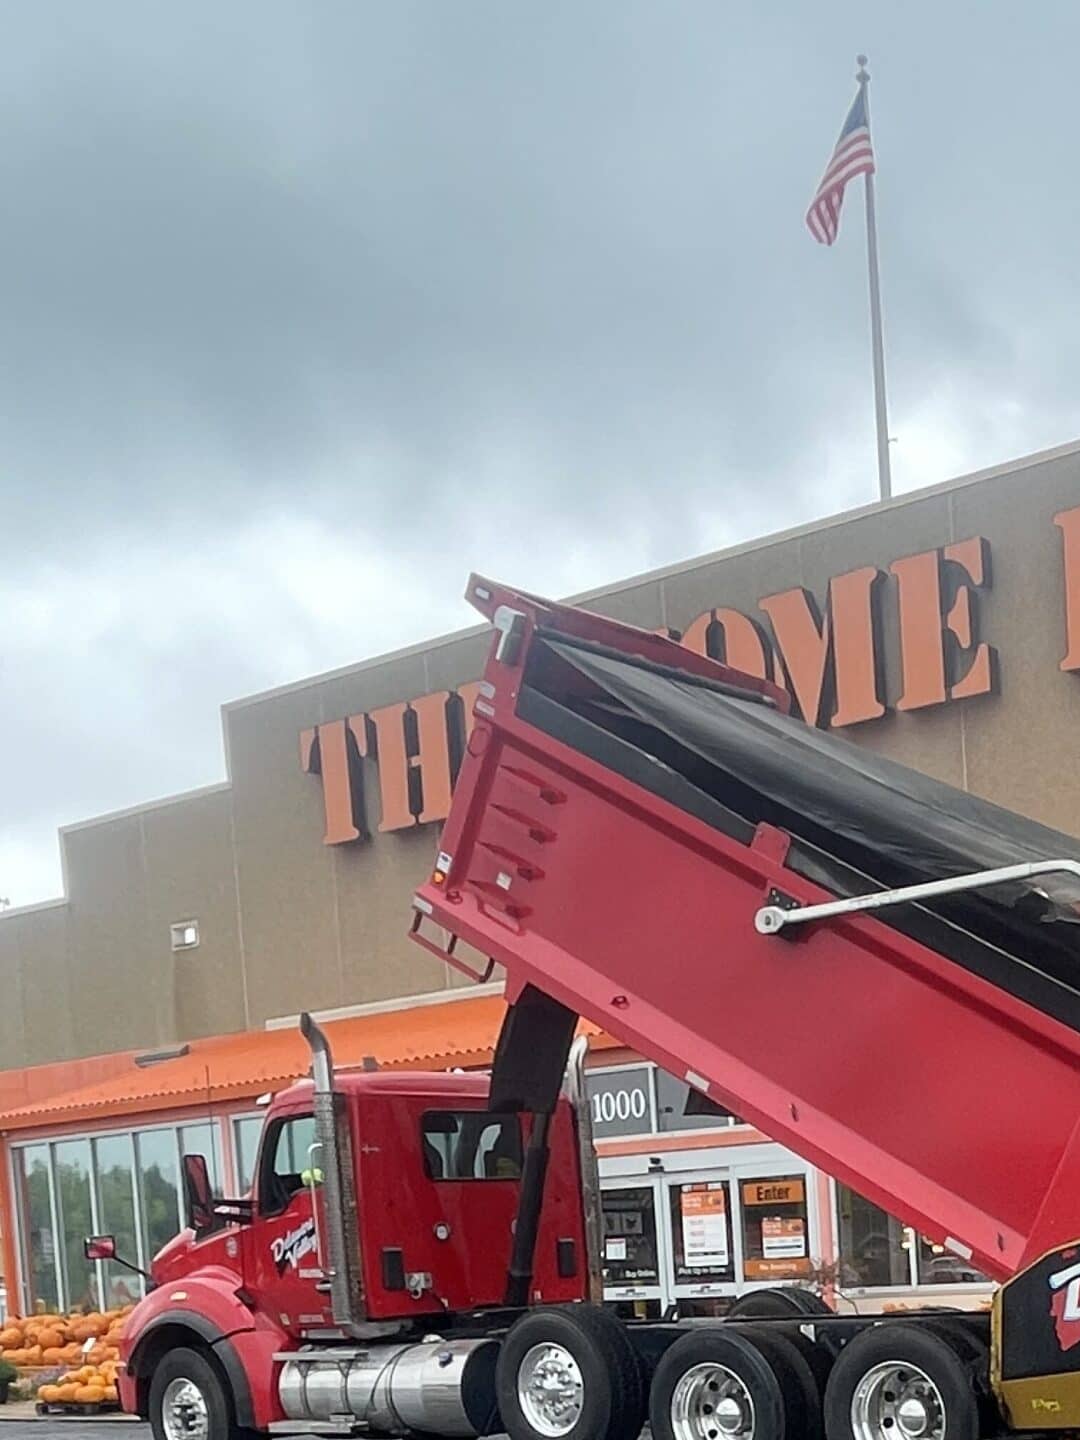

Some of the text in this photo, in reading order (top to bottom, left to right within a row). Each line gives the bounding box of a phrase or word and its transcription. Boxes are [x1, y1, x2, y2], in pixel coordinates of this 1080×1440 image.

[300, 680, 483, 845] TH
[592, 1088, 646, 1123] 1000
[756, 1184, 791, 1200] Enter
